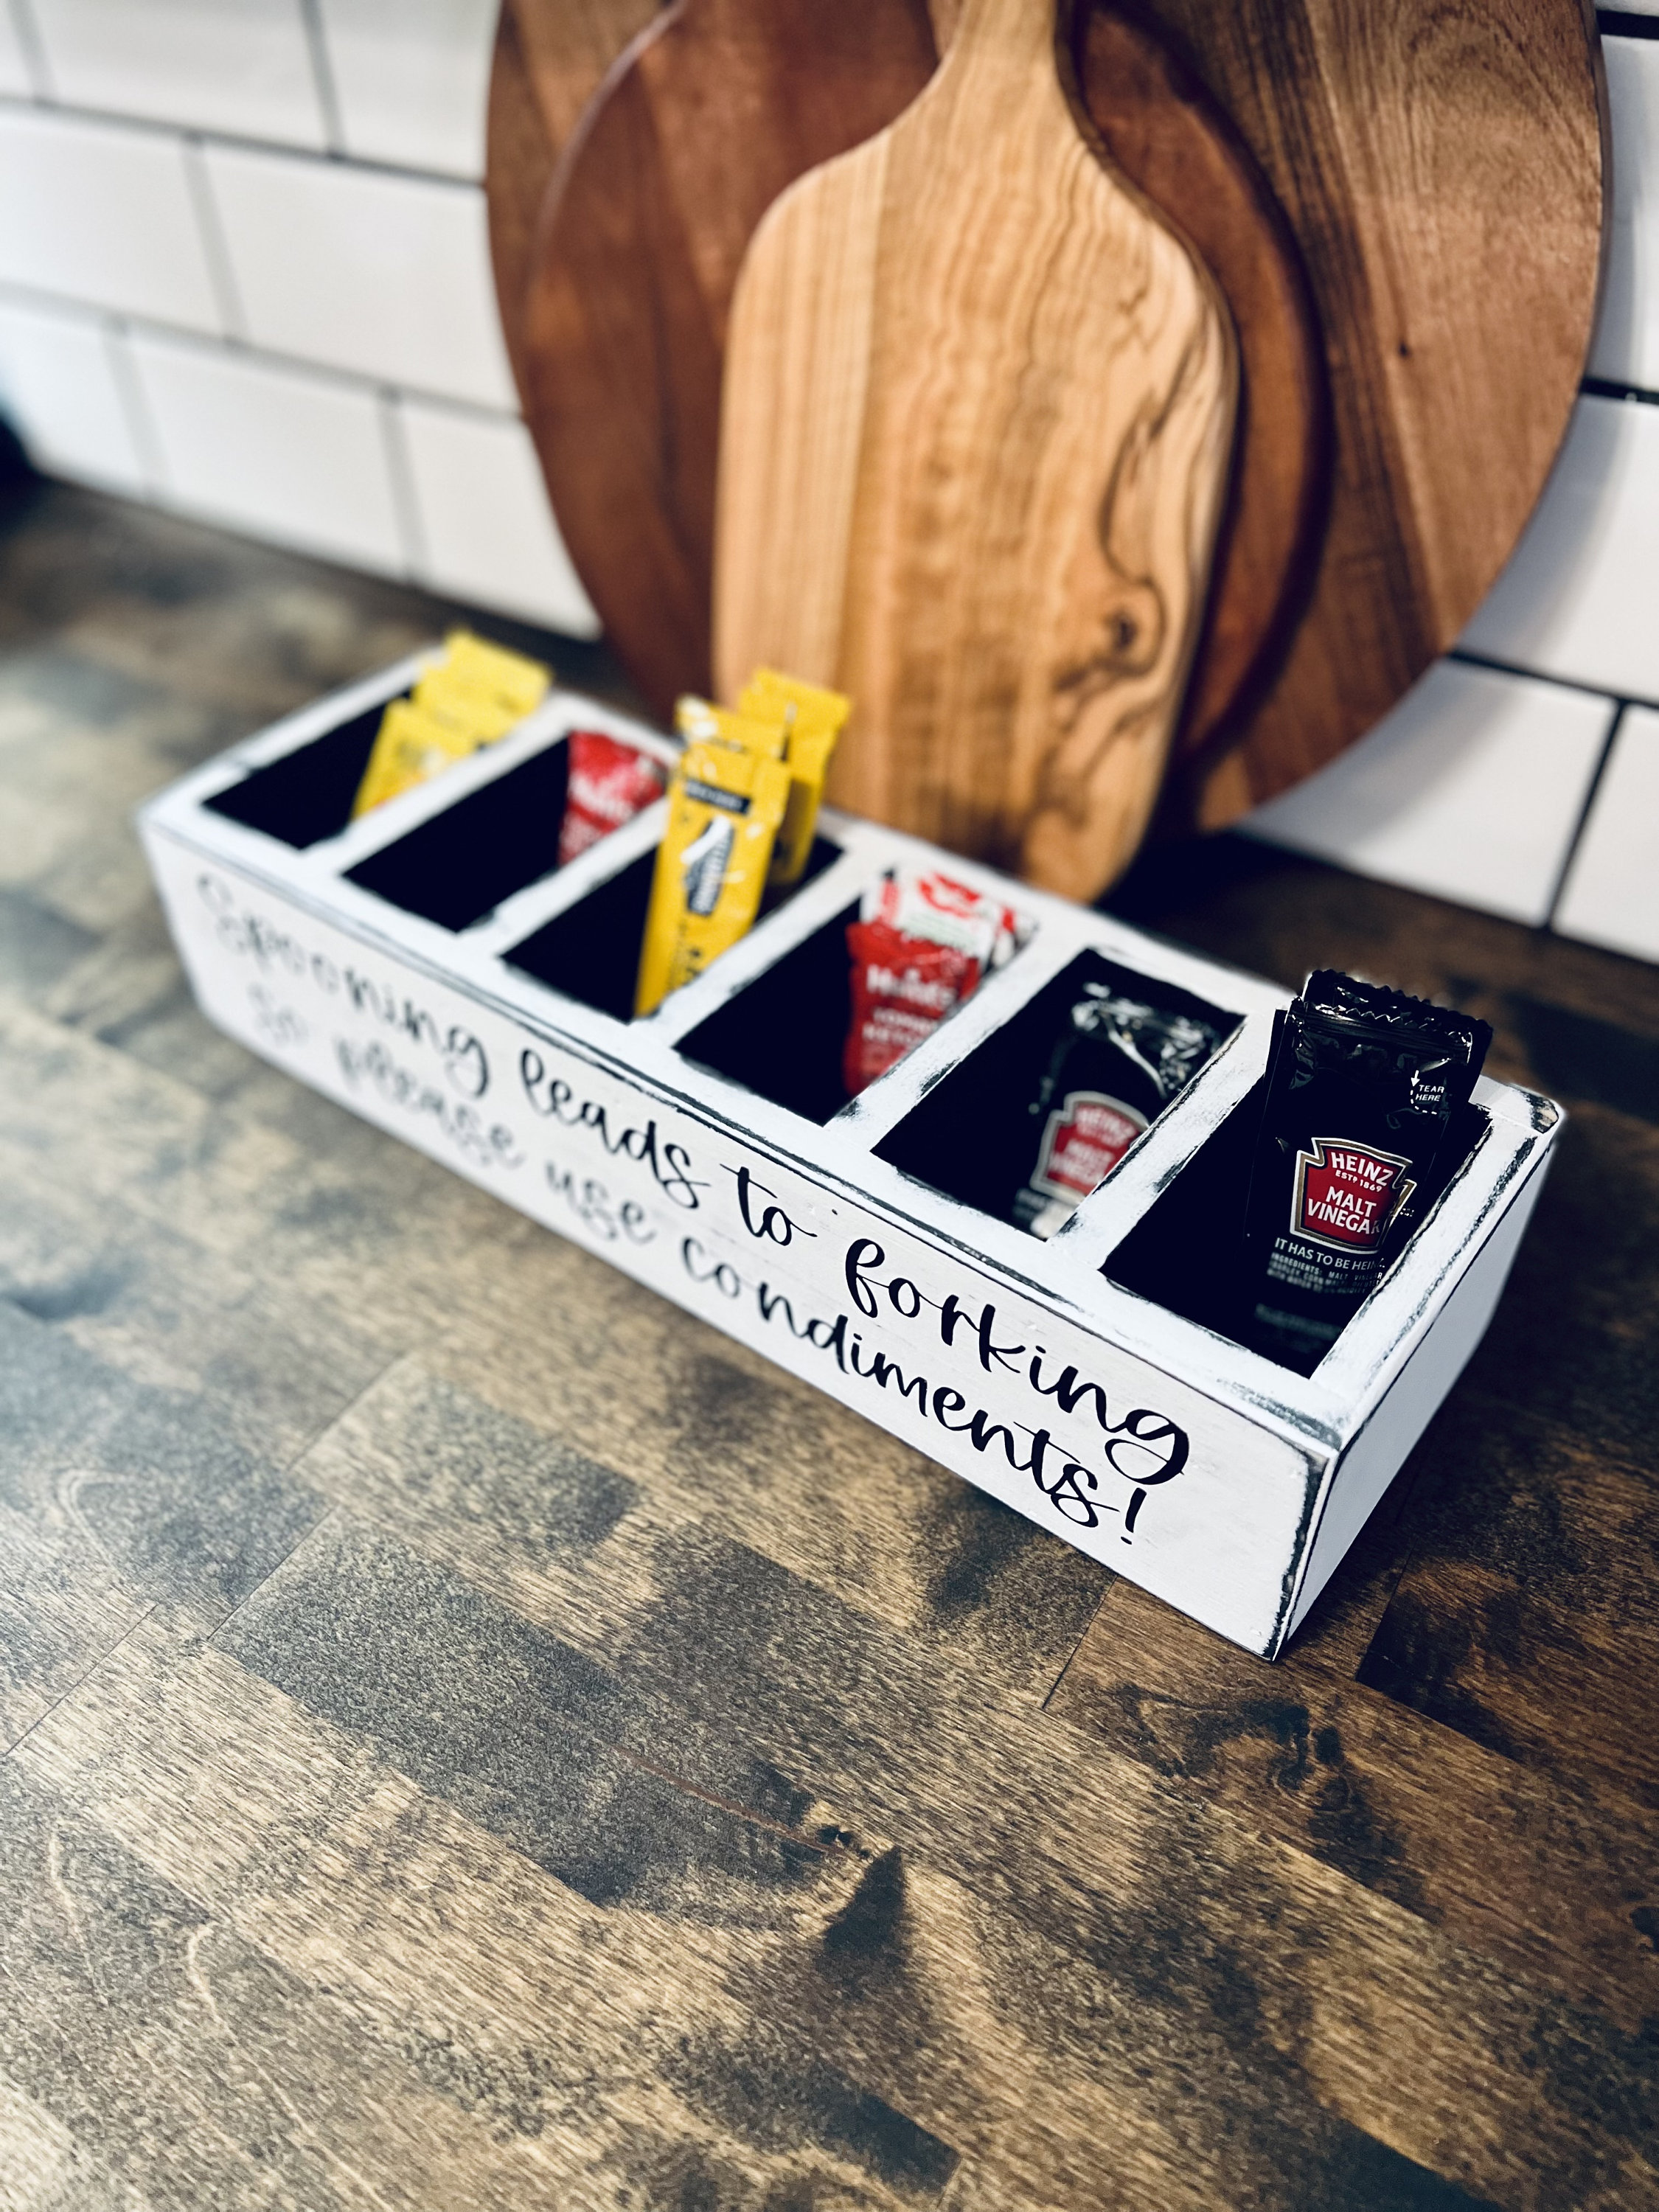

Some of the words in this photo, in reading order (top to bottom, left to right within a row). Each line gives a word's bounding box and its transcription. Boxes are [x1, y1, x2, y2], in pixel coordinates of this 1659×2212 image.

[1415, 1093, 1441, 1102] HERE
[1419, 1085, 1444, 1093] TEAR
[197, 874, 490, 1099] Spooning
[520, 1048, 710, 1210] leads
[719, 1165, 818, 1246] to
[844, 1238, 1190, 1486] forking
[1331, 1152, 1394, 1186] HEINZ
[1326, 1186, 1377, 1217] MALT
[1360, 1180, 1382, 1192] 1869
[1307, 1198, 1380, 1234] VINEGAR
[1274, 1237, 1287, 1250] IT
[1287, 1242, 1314, 1260] HAS
[1316, 1252, 1333, 1265] TO
[1335, 1258, 1351, 1269] BE
[334, 1036, 526, 1168] please
[544, 1156, 657, 1245] use
[681, 1236, 1147, 1545] condiments!
